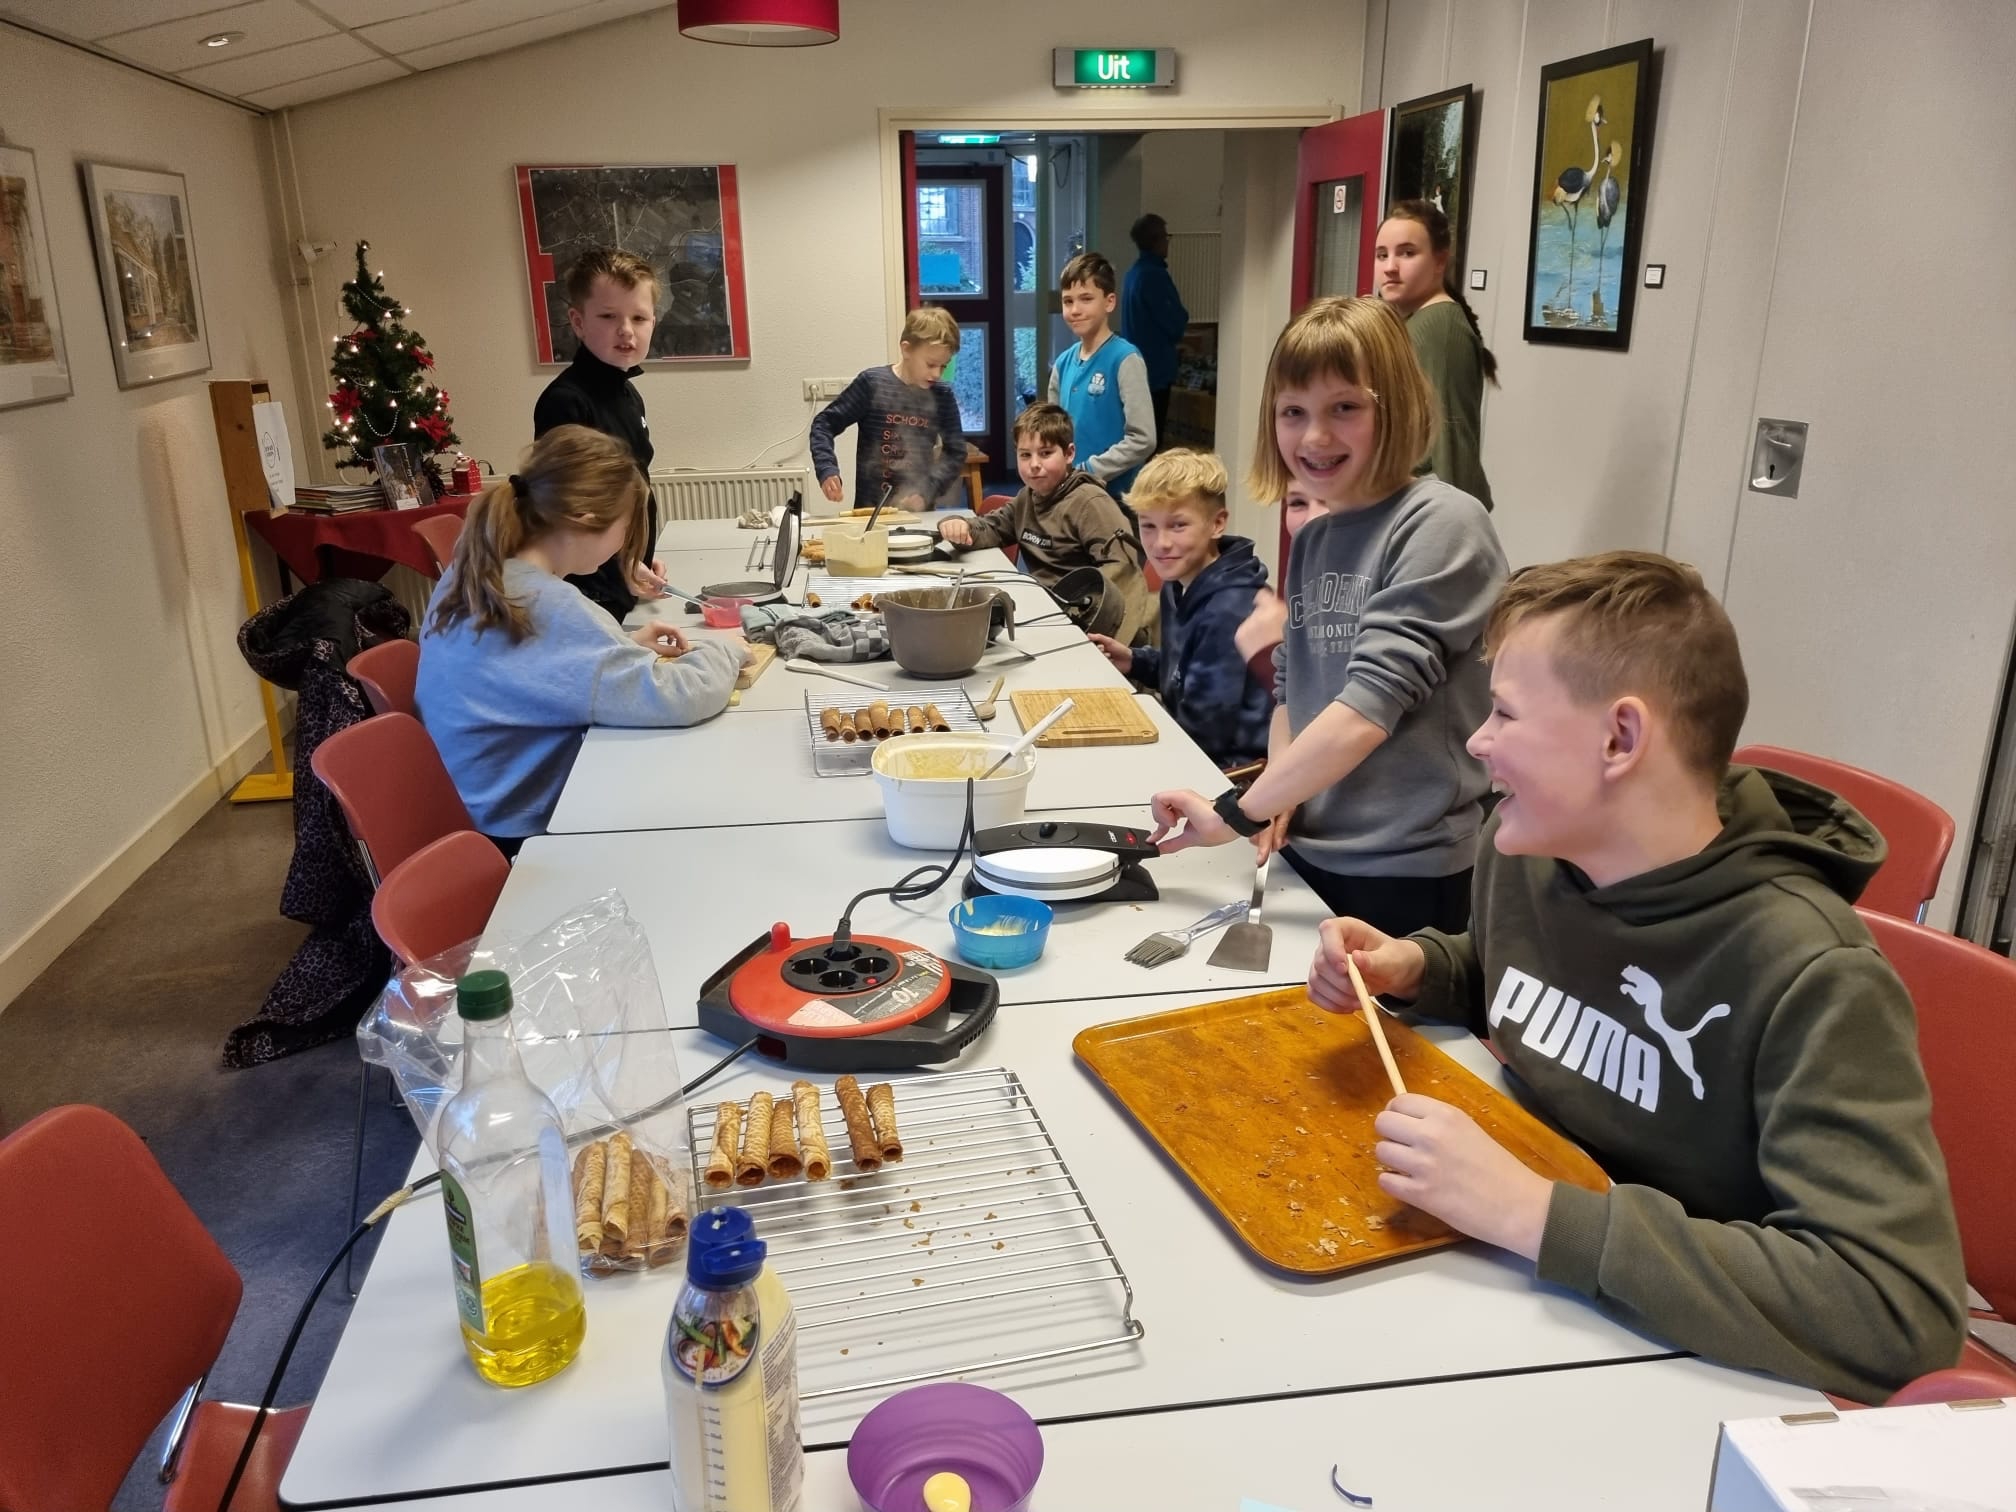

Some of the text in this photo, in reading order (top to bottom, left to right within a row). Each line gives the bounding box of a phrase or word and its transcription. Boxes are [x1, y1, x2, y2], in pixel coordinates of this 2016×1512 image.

[1097, 54, 1131, 80] Uit
[885, 414, 929, 428] SCHOOL
[1489, 966, 1660, 1113] PUMA
